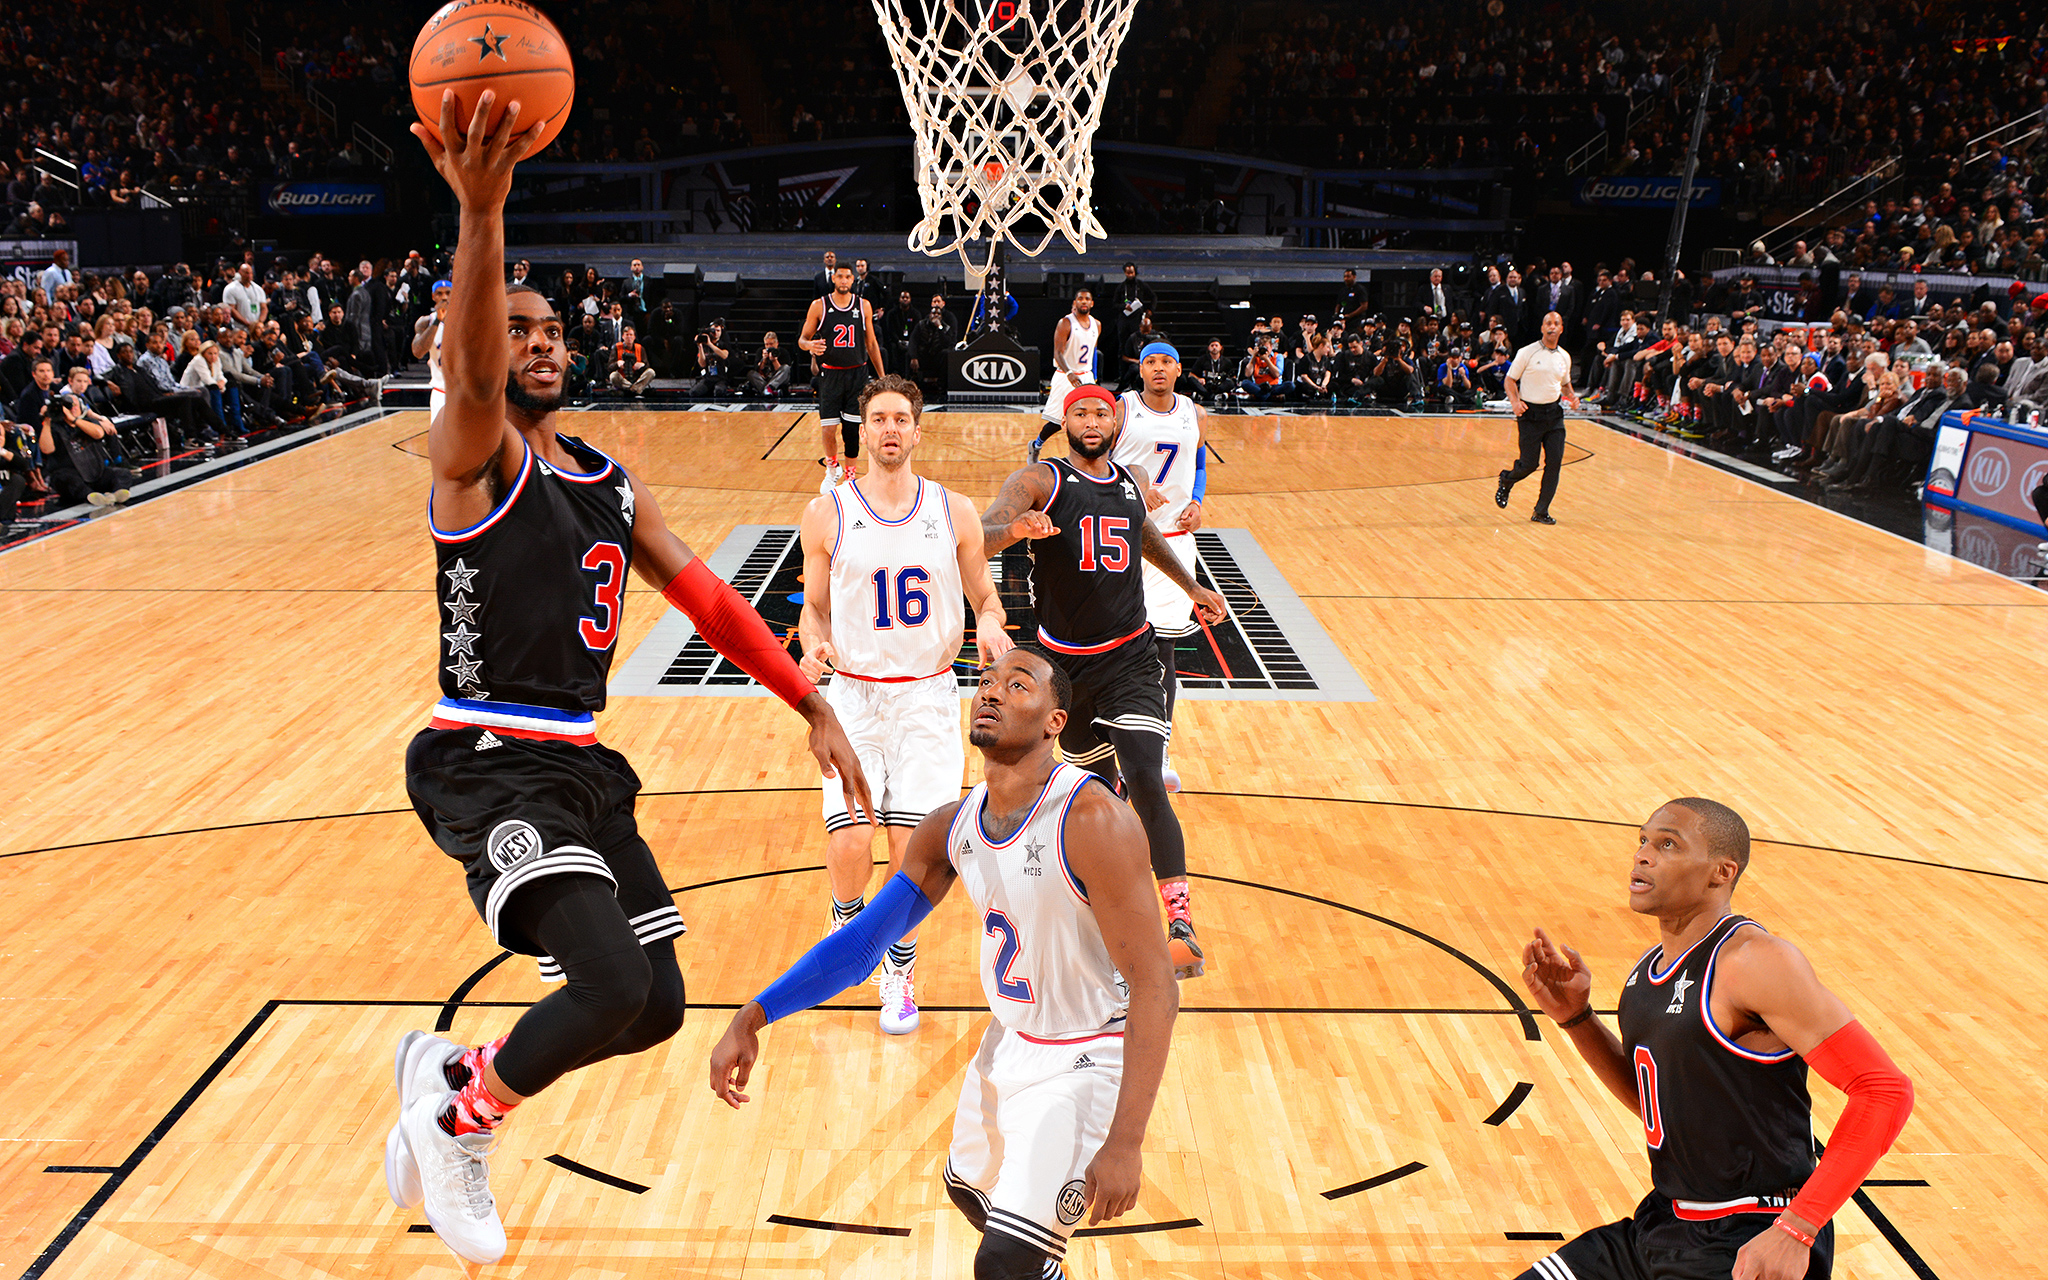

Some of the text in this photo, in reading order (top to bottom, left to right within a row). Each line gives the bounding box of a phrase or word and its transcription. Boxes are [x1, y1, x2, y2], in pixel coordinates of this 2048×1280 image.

[277, 192, 376, 205] BUD LIGHT
[1590, 183, 1640, 198] BUD
[833, 324, 855, 347] 21
[973, 361, 1015, 381] KIA
[1078, 344, 1089, 364] 2
[1152, 441, 1180, 486] 7
[1973, 455, 2002, 488] KIA
[1079, 514, 1130, 573] 15
[577, 539, 627, 652] 3
[870, 564, 931, 631] 16
[475, 740, 503, 751] adidas
[496, 831, 532, 866] WEST
[983, 907, 1036, 1004] 2
[1634, 1044, 1665, 1151] 0
